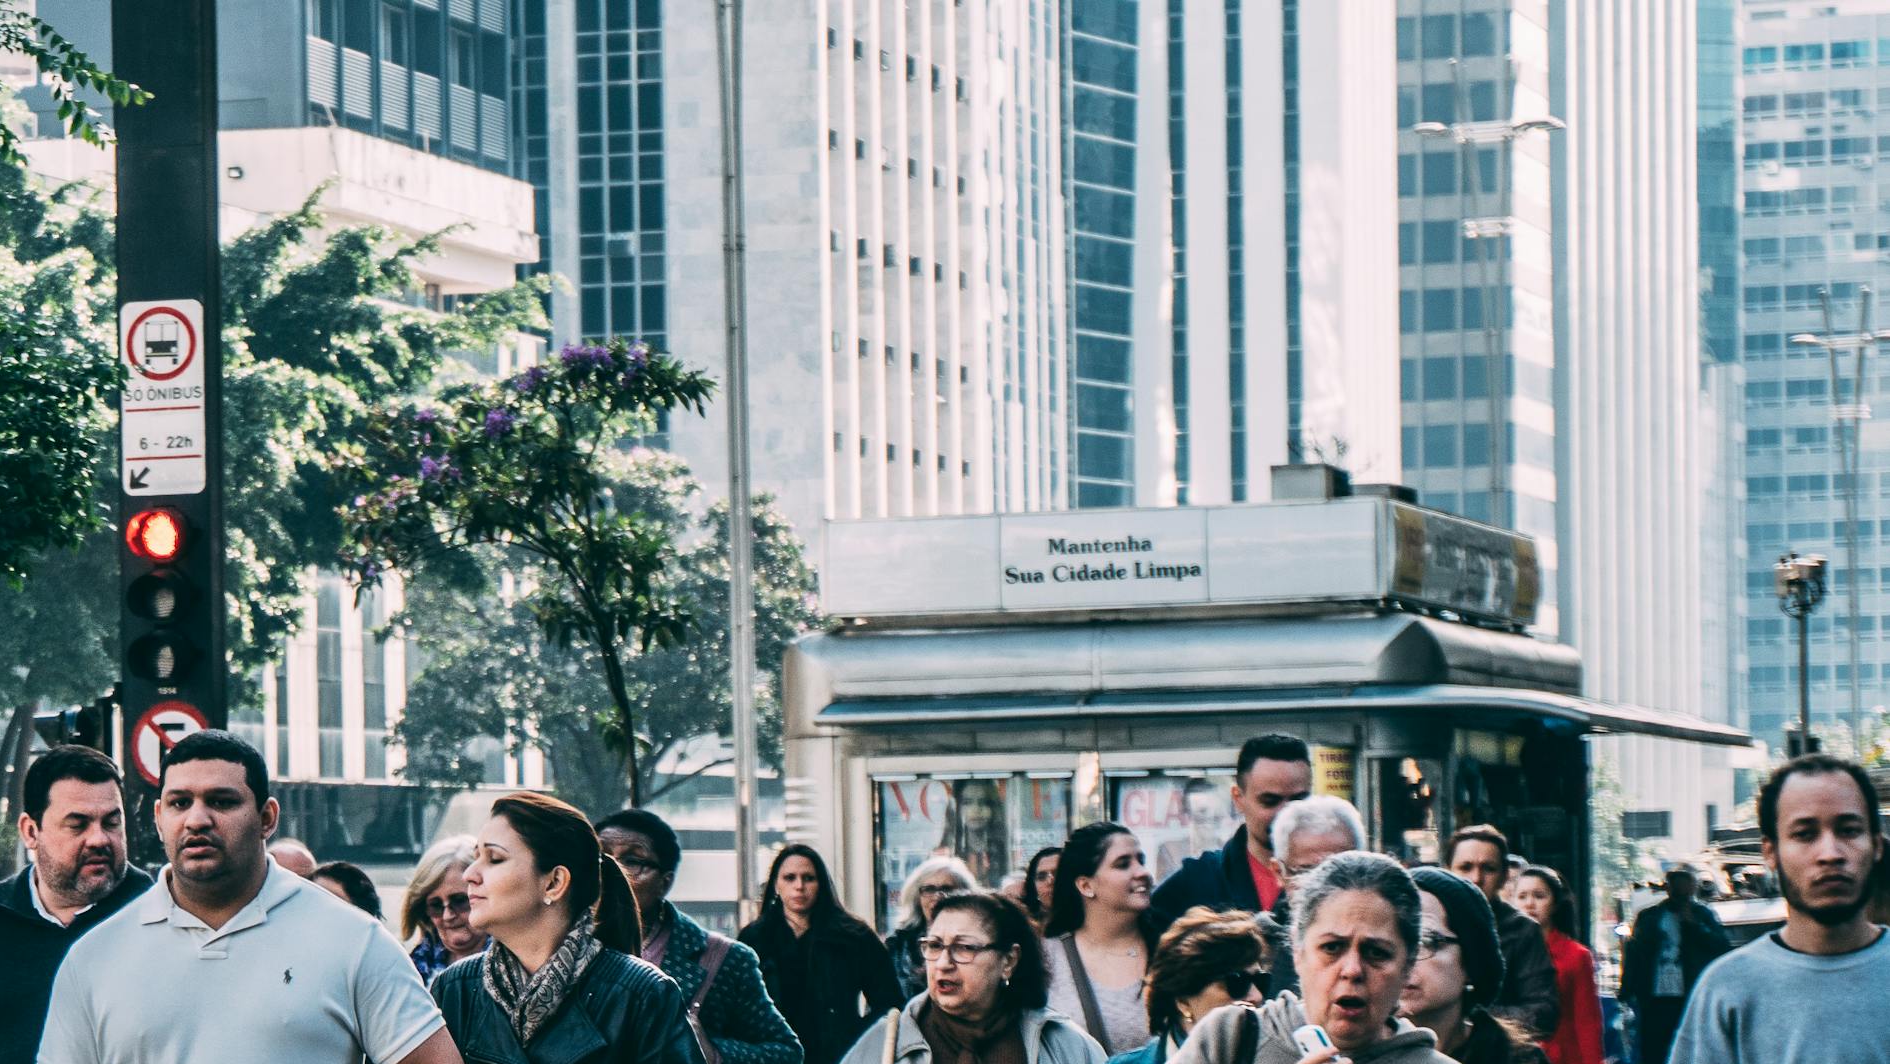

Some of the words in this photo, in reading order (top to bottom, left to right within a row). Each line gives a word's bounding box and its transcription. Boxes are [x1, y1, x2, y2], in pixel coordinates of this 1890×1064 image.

[139, 437, 149, 450] 6
[166, 435, 193, 449] 22h
[1048, 535, 1153, 556] Mantenha
[1005, 565, 1045, 584] Sua
[1052, 563, 1129, 583] Cidade
[1134, 561, 1202, 580] Limpa
